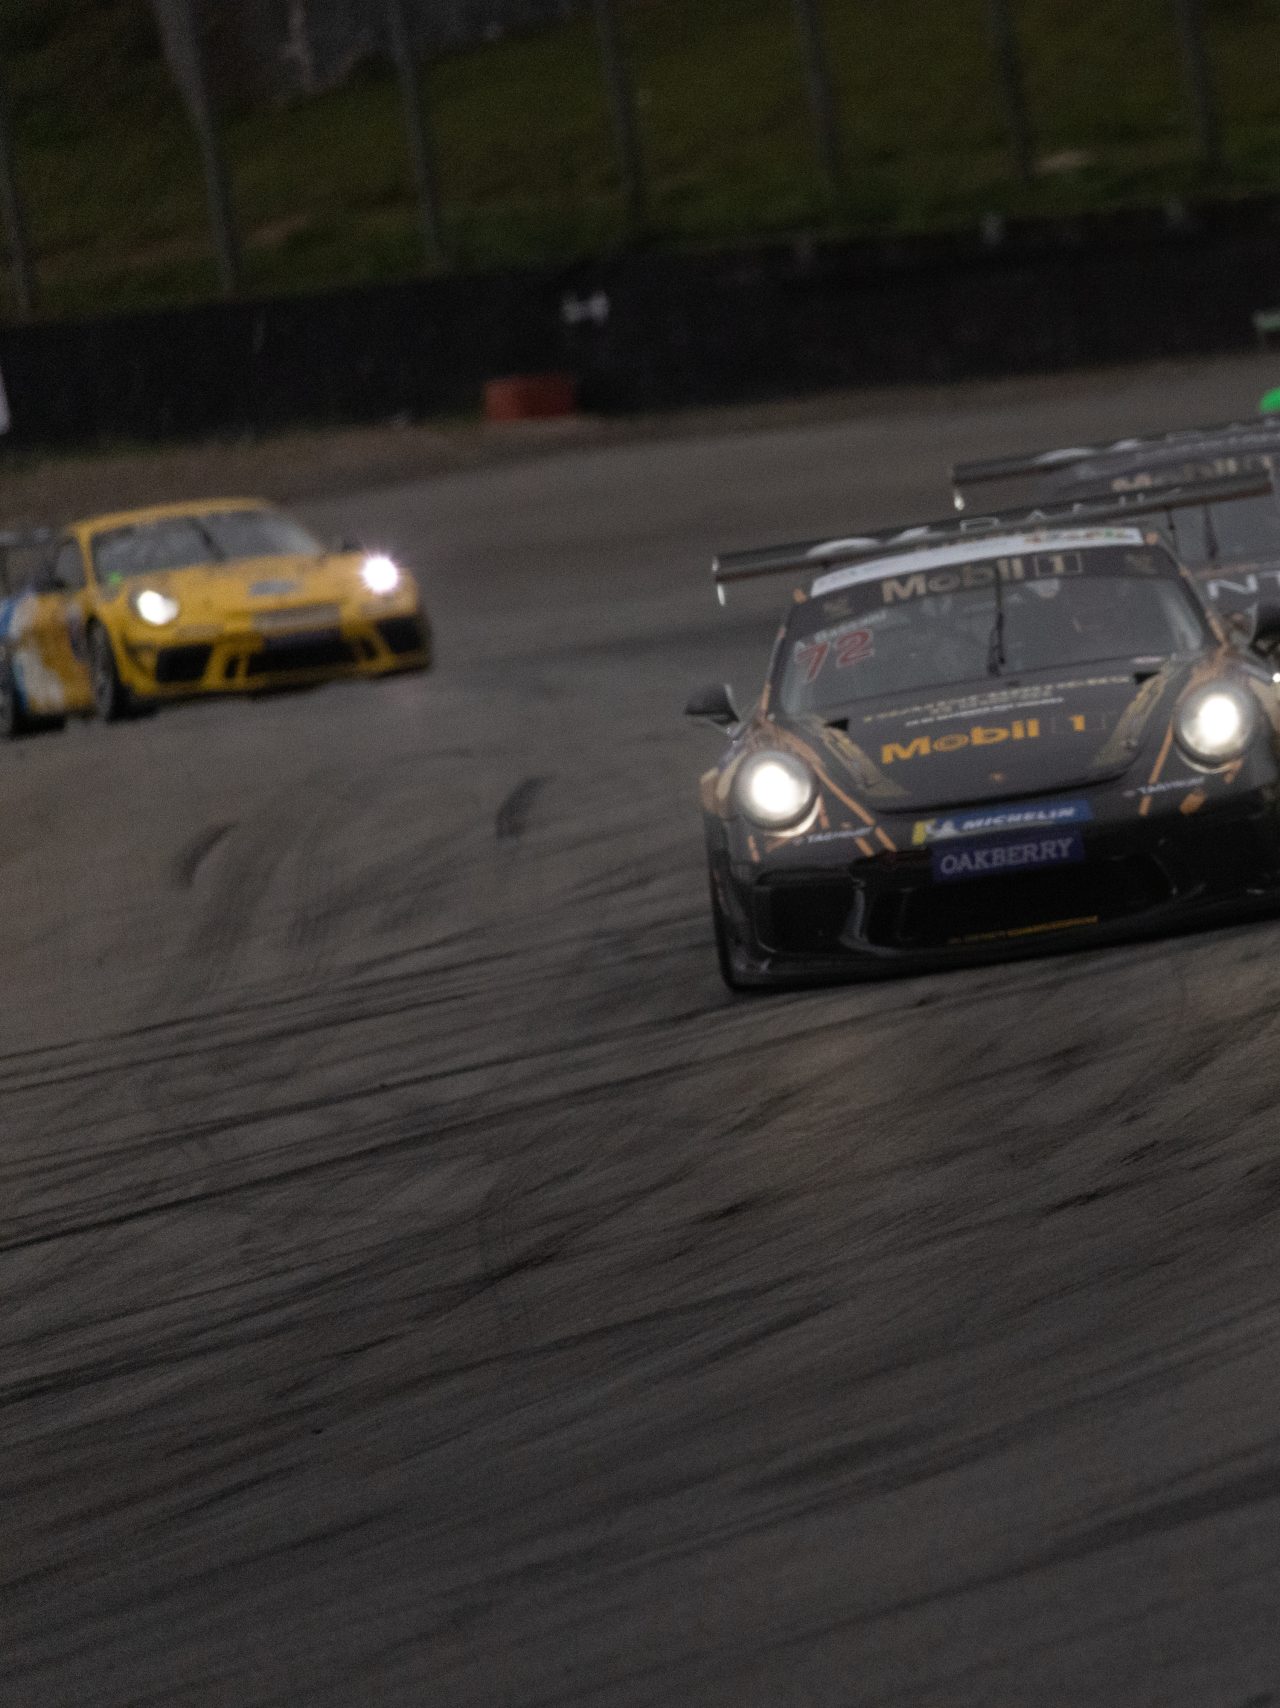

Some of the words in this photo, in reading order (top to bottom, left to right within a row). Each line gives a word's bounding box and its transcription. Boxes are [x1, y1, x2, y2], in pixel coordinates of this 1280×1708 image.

[881, 557, 1024, 603] Mobil
[794, 628, 875, 681] 72
[881, 718, 1040, 765] Mobil
[940, 837, 1074, 875] OAKBERRY
